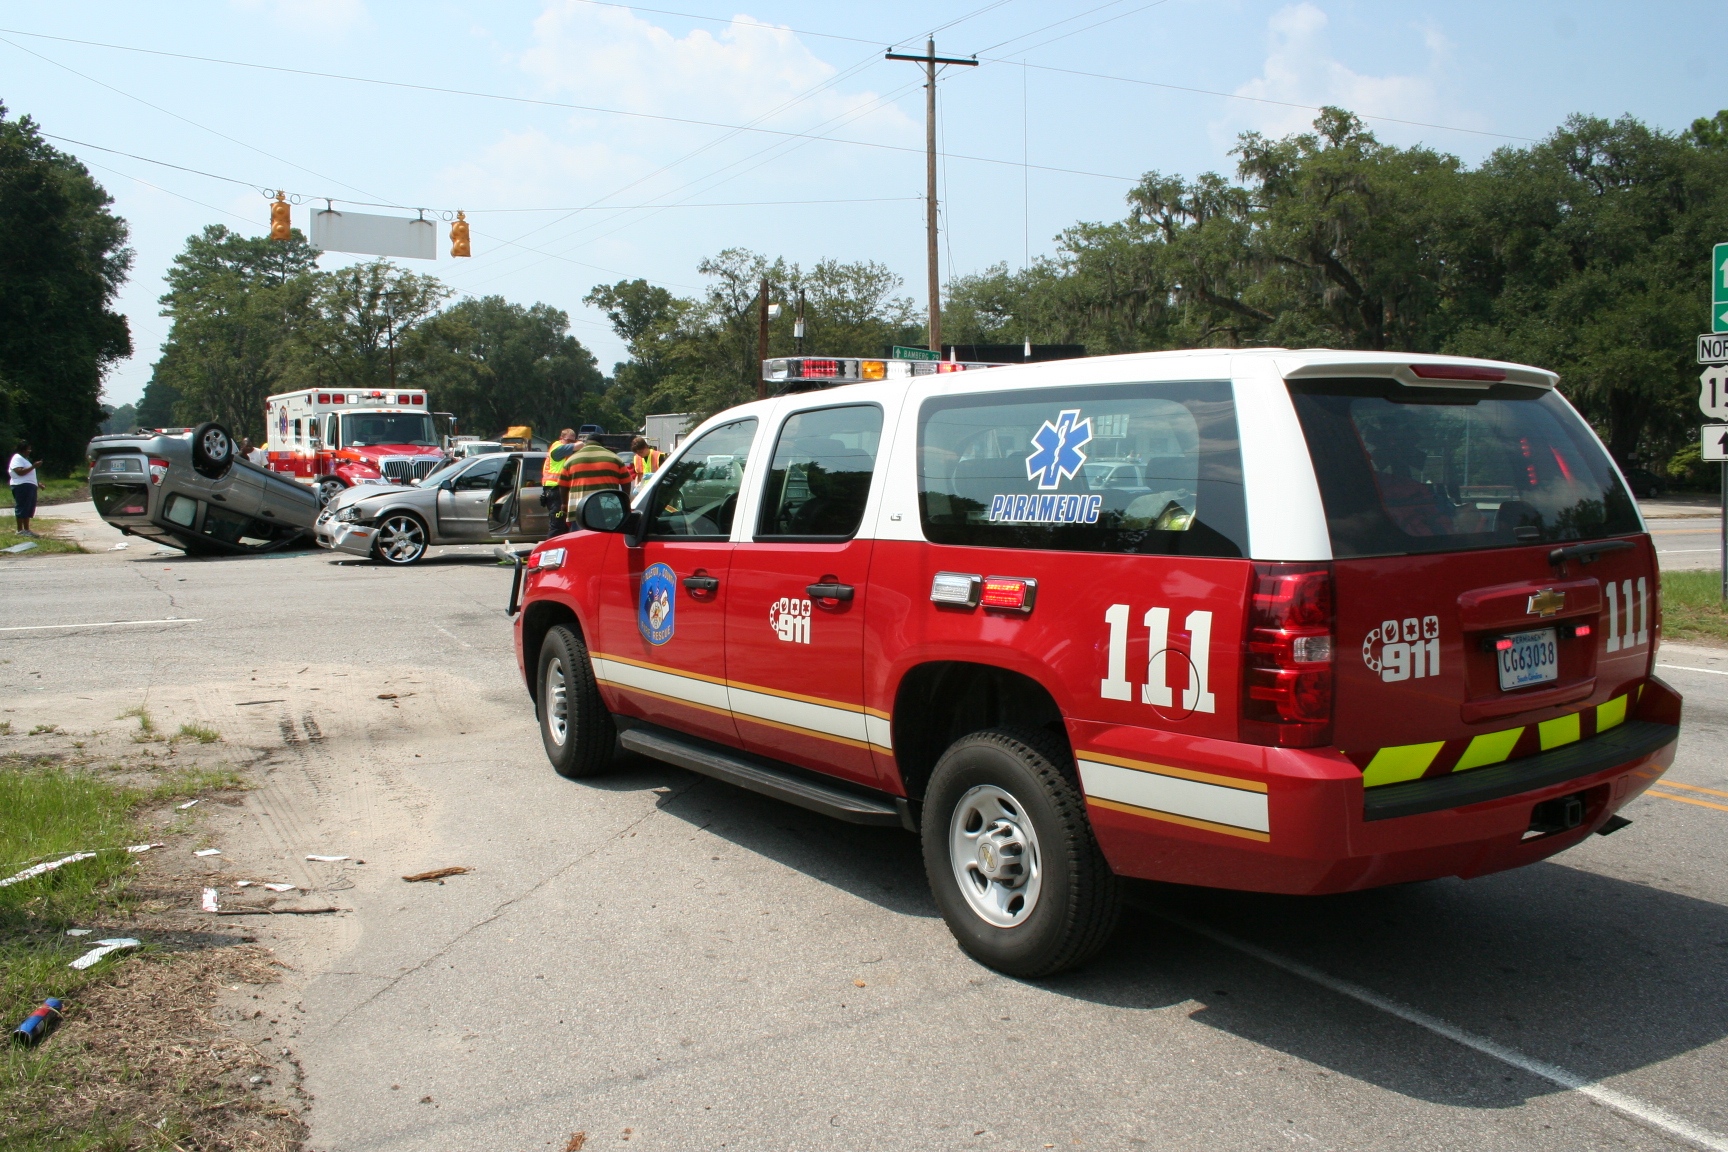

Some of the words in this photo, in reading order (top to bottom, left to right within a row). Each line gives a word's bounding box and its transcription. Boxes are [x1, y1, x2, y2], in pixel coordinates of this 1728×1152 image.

[904, 350, 929, 360] BAMBERG
[989, 494, 1102, 524] PARAMEDIC
[778, 613, 812, 645] 911
[1605, 576, 1649, 653] 111
[652, 624, 671, 641] RESCUE
[1512, 633, 1544, 644] PERMANENT
[1100, 603, 1216, 714] 111
[1381, 637, 1440, 683] 911
[1503, 641, 1554, 673] CG63038
[1516, 675, 1528, 683] South
[1528, 673, 1543, 681] Carolina
